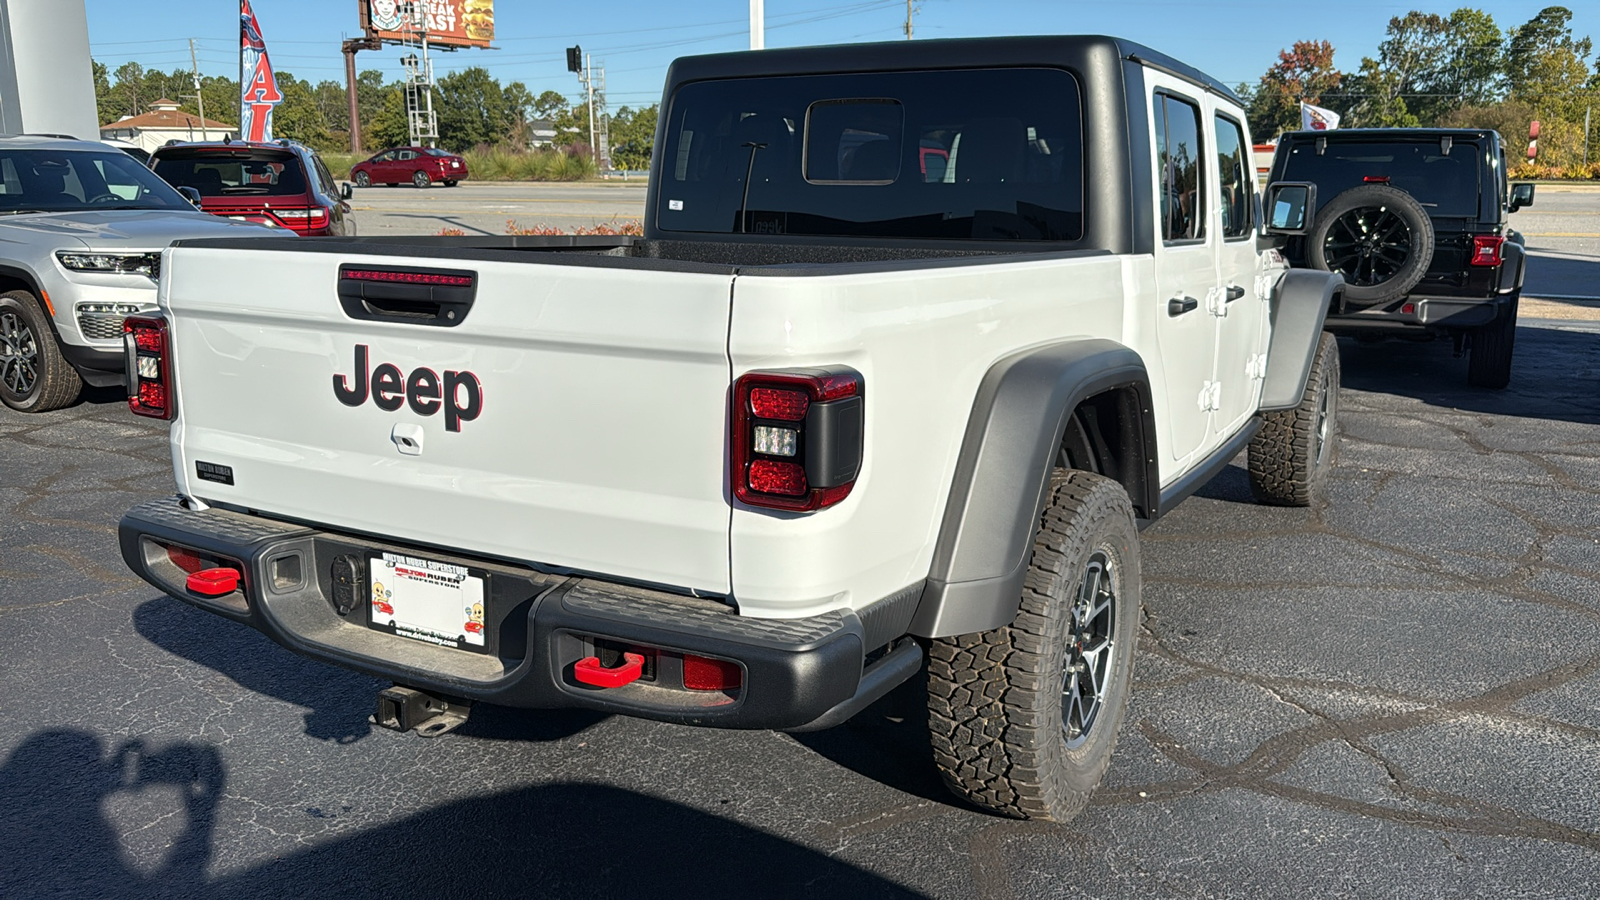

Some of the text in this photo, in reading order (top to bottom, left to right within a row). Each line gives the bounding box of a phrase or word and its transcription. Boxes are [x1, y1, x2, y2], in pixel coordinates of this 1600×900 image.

[332, 343, 483, 433] Jeep
[405, 556, 427, 568] RUBEN
[427, 560, 469, 576] SUPERSTORE
[395, 567, 461, 584] MILTON RUBEN
[408, 576, 461, 589] SUPERSTORE
